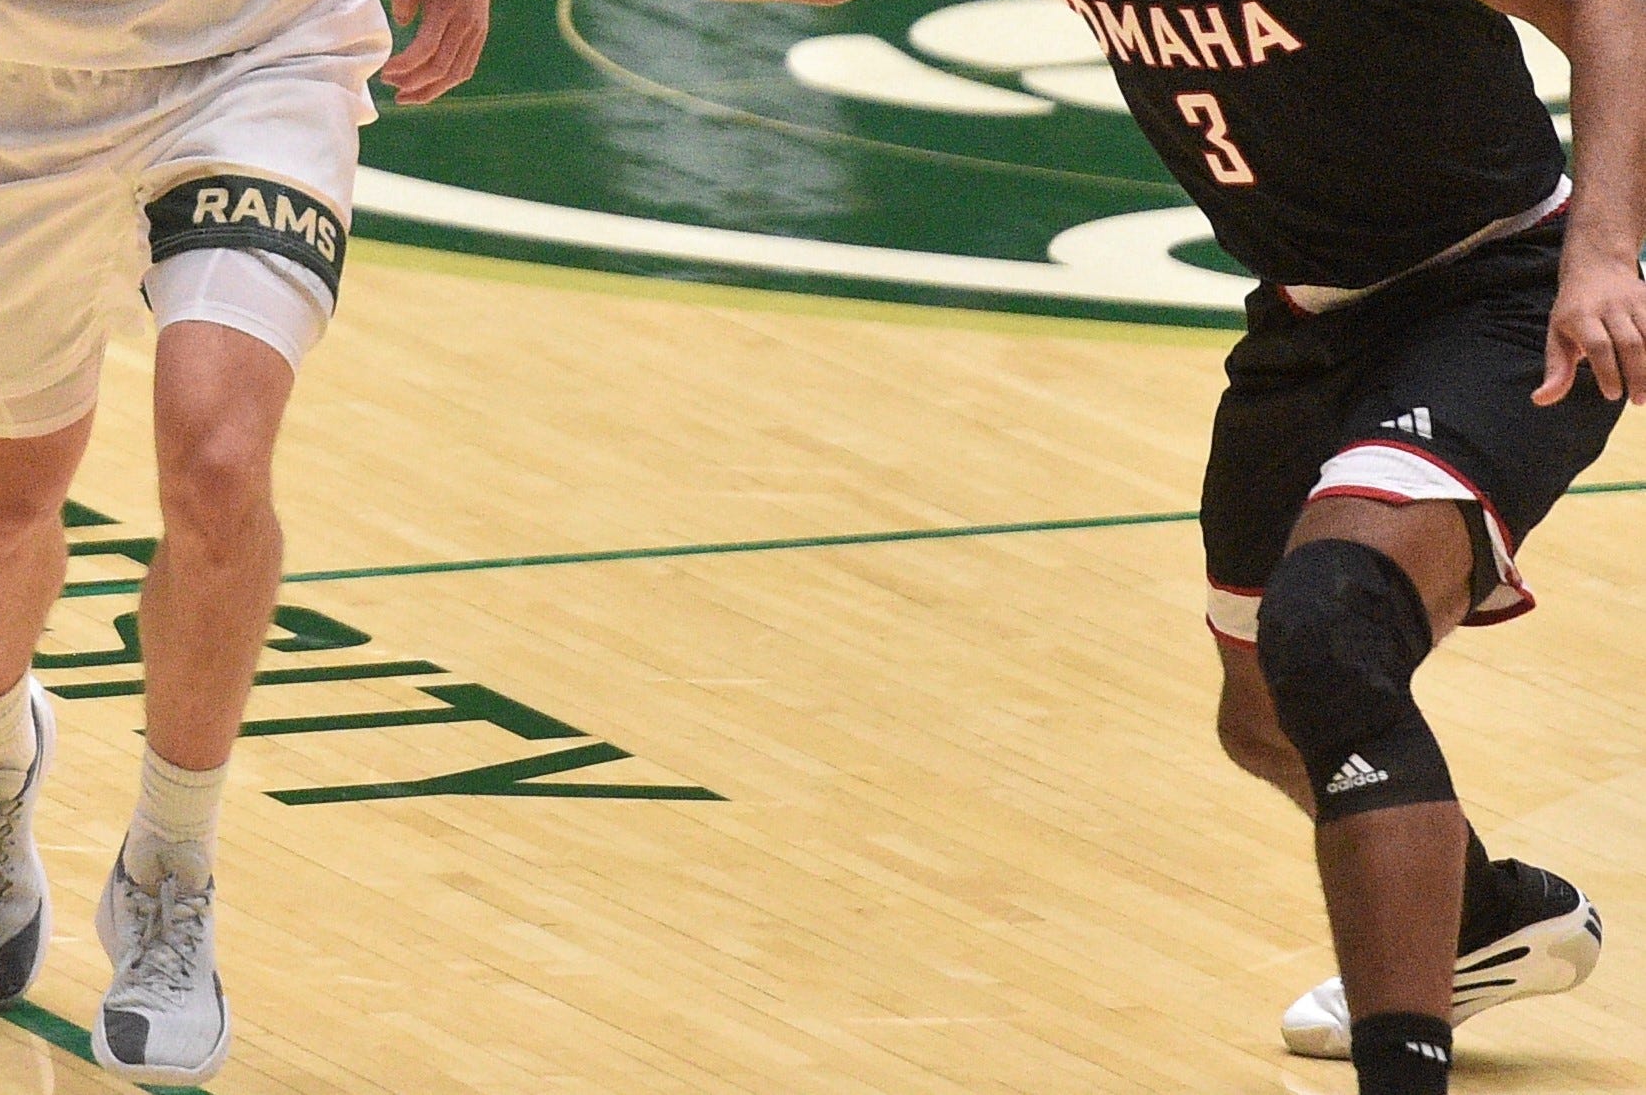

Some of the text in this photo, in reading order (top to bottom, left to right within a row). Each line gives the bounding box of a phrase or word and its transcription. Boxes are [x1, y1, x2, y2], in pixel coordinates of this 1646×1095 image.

[1175, 91, 1256, 186] 3
[192, 186, 337, 263] RAMS
[1326, 769, 1389, 793] adidas
